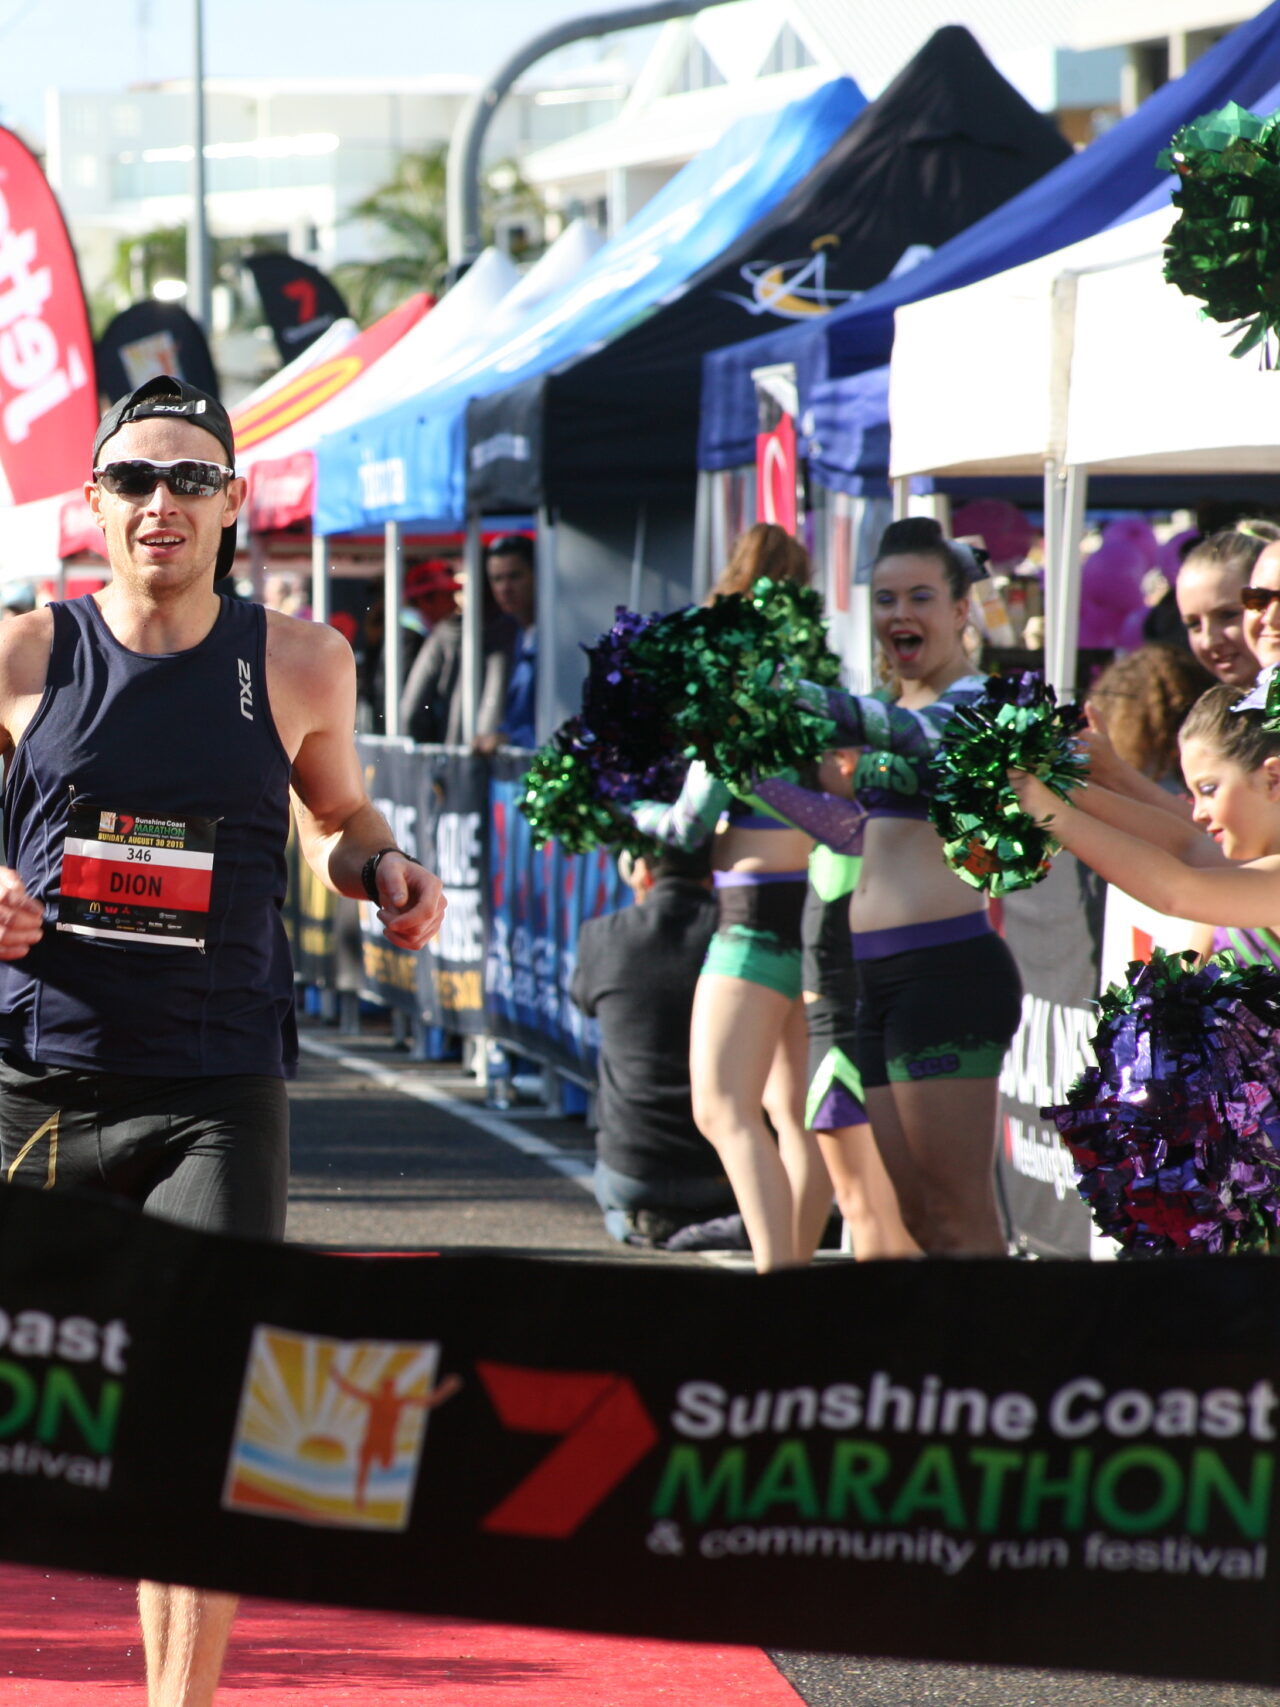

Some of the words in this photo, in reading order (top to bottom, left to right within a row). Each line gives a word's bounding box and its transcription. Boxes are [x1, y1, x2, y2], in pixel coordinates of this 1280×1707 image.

[237, 657, 254, 721] 2XU
[134, 824, 186, 836] MARATHON
[135, 816, 165, 827] Sunshine
[166, 819, 186, 828] Coast
[98, 832, 126, 844] SUNDAY,
[127, 836, 154, 846] AUGUST
[155, 839, 165, 847] 30
[166, 840, 185, 848] 2015
[126, 847, 152, 862] 346
[109, 871, 163, 898] DION
[671, 1371, 1037, 1441] Sunshine
[1048, 1378, 1278, 1442] Coast
[651, 1440, 1274, 1540] MARATHON
[646, 1520, 683, 1556] &
[700, 1525, 974, 1576] community
[989, 1534, 1069, 1570] run
[1085, 1530, 1267, 1580] festival
